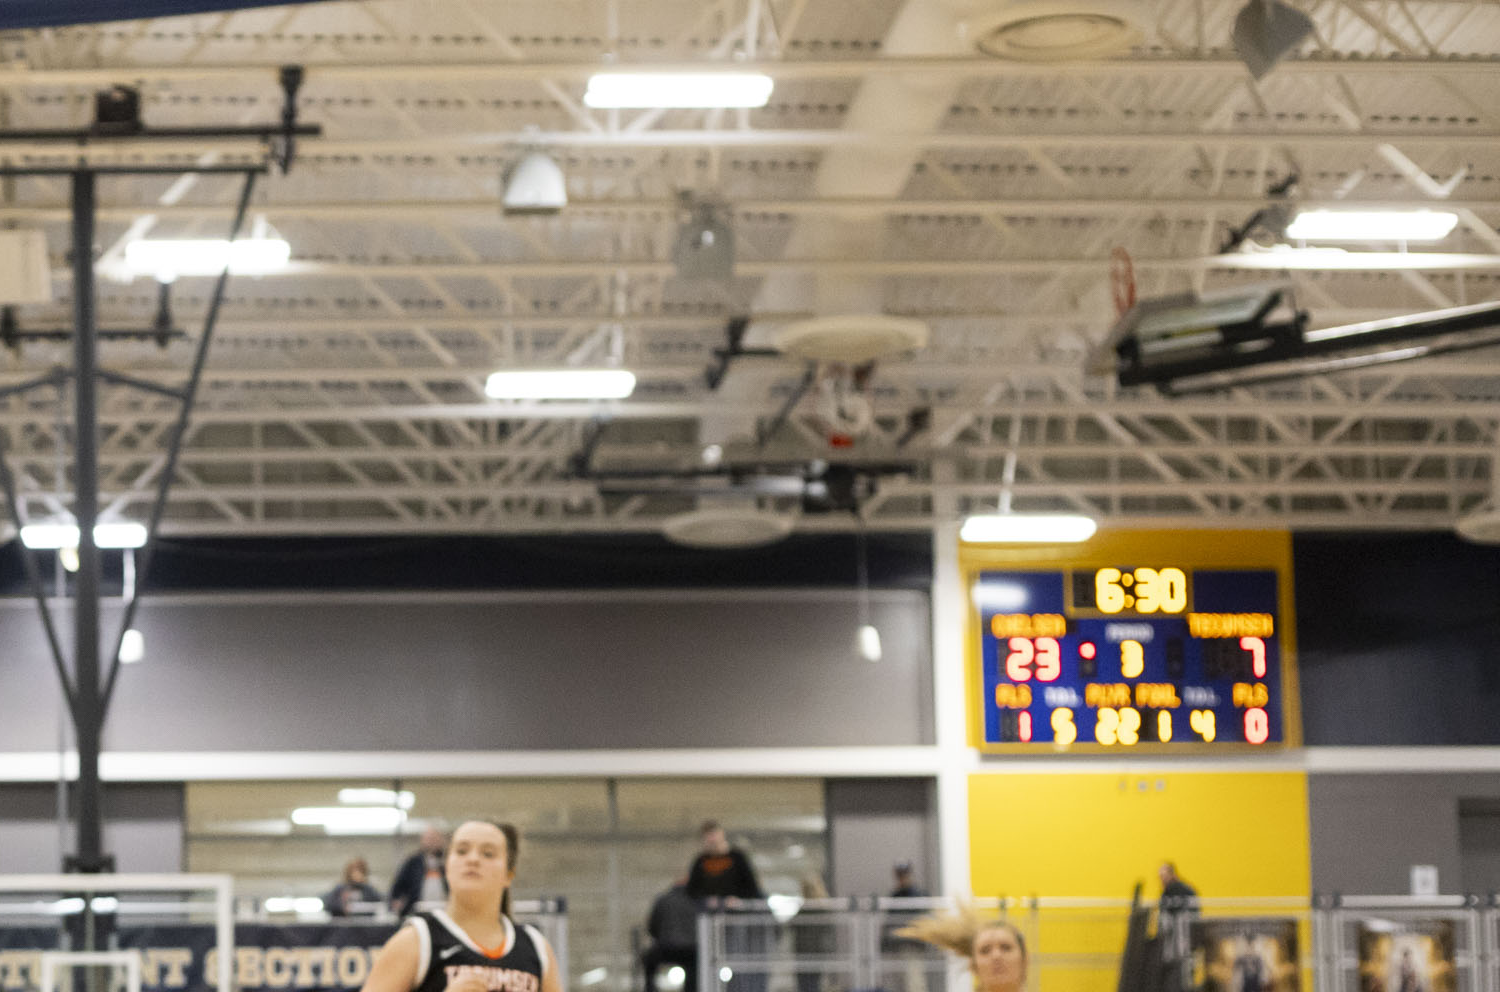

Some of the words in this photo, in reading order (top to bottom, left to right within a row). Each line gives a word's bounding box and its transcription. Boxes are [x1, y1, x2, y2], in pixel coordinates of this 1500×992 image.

[1095, 567, 1187, 613] 6:30
[1005, 637, 1061, 682] 23
[1239, 636, 1266, 678] 7
[1018, 710, 1032, 743] 1
[1050, 707, 1077, 745] 5
[1190, 709, 1216, 743] 4
[1244, 707, 1269, 745] 0
[204, 947, 390, 988] SECTIO
